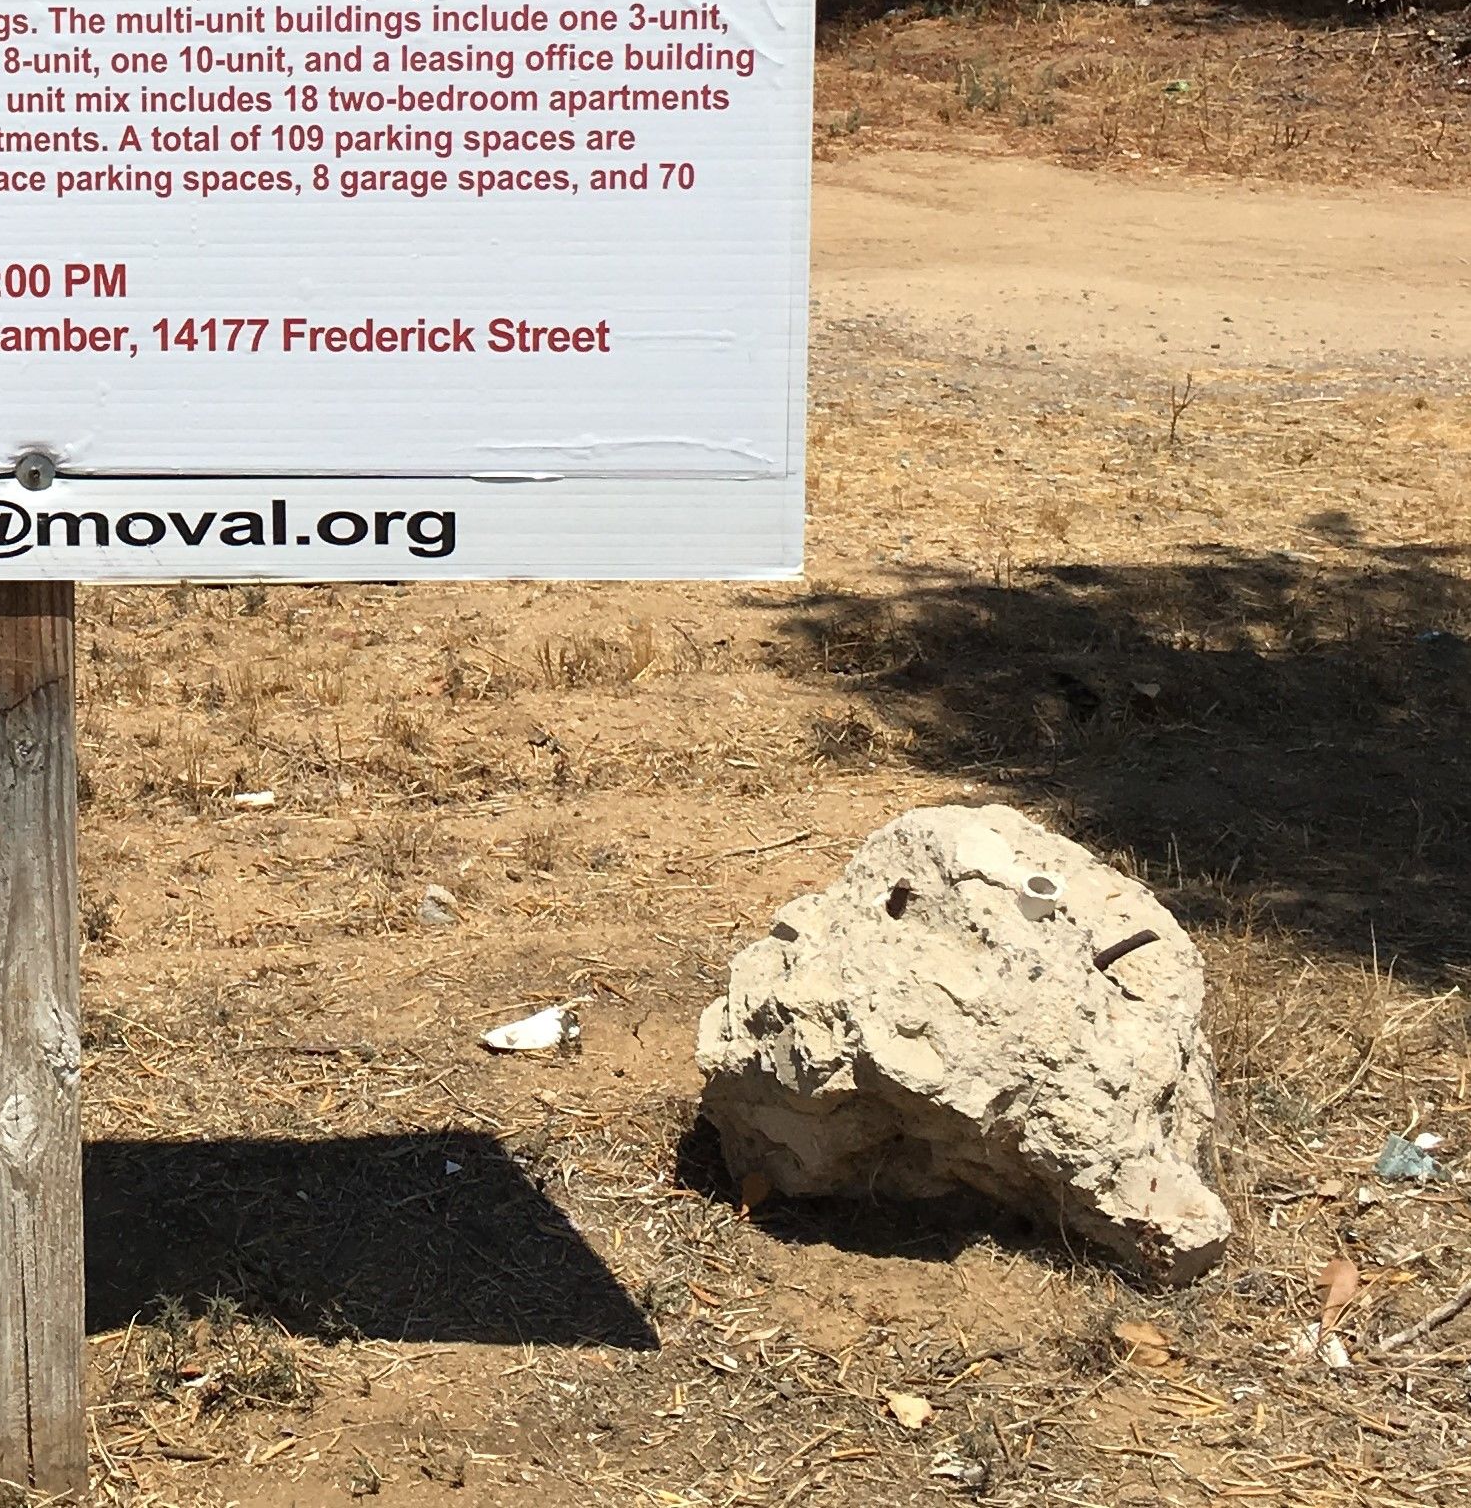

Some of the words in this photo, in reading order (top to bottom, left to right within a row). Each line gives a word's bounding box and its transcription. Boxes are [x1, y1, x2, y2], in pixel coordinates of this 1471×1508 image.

[47, 6, 106, 35] The
[116, 5, 266, 34] multi-unit
[275, 4, 422, 40] buildings
[433, 3, 549, 32] include
[558, 9, 618, 32] one
[628, 2, 729, 35] 3-unit,
[3, 46, 100, 79] 8-unit,
[110, 52, 168, 74] one
[179, 45, 294, 78] 10-unit,
[304, 44, 362, 73] and
[372, 51, 390, 73] a
[401, 44, 514, 79] leasing
[525, 43, 614, 72] office
[624, 42, 755, 78] building
[6, 86, 66, 114] unit
[75, 85, 131, 113] mix
[141, 85, 273, 113] includes
[284, 84, 319, 113] 18
[327, 84, 538, 112] two-bedroom
[548, 83, 730, 118] apartments
[118, 124, 143, 152] A
[150, 124, 219, 152] total
[230, 124, 262, 152] of
[271, 124, 324, 152] 109
[335, 123, 453, 159] parking
[463, 129, 576, 158] spaces
[586, 129, 636, 151] are
[56, 163, 173, 199] parking
[182, 170, 302, 198] spaces,
[312, 163, 330, 191] 8
[340, 169, 448, 198] garage
[457, 169, 579, 198] spaces,
[589, 162, 648, 191] and
[659, 162, 695, 190] 70
[64, 263, 127, 298] PM
[152, 317, 270, 353] 14177
[282, 317, 476, 353] Frederick
[487, 317, 611, 353] Street
